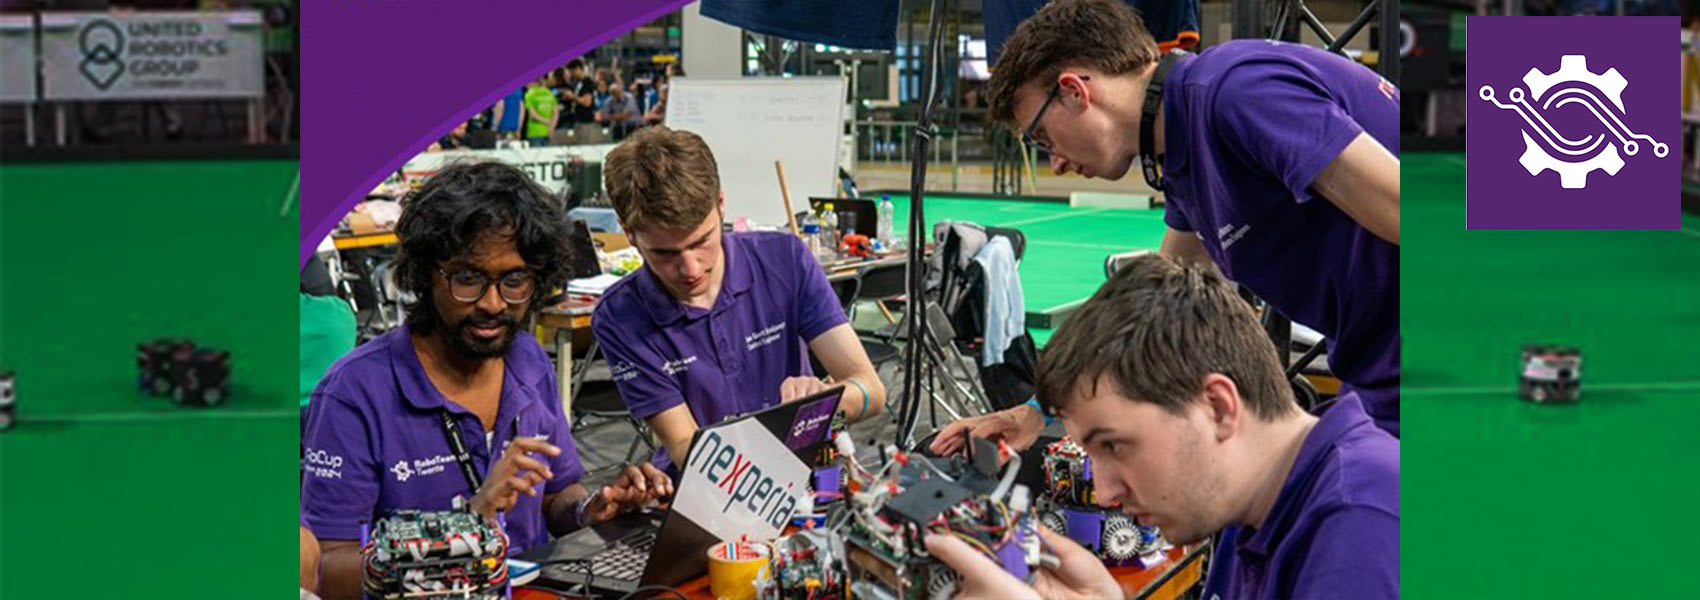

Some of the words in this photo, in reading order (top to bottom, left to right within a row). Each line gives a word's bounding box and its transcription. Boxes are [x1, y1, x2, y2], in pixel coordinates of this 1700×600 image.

[128, 22, 202, 36] UNITED
[128, 39, 227, 57] ROBOTICS
[129, 59, 200, 76] GROUP
[690, 431, 796, 530] nexperia
